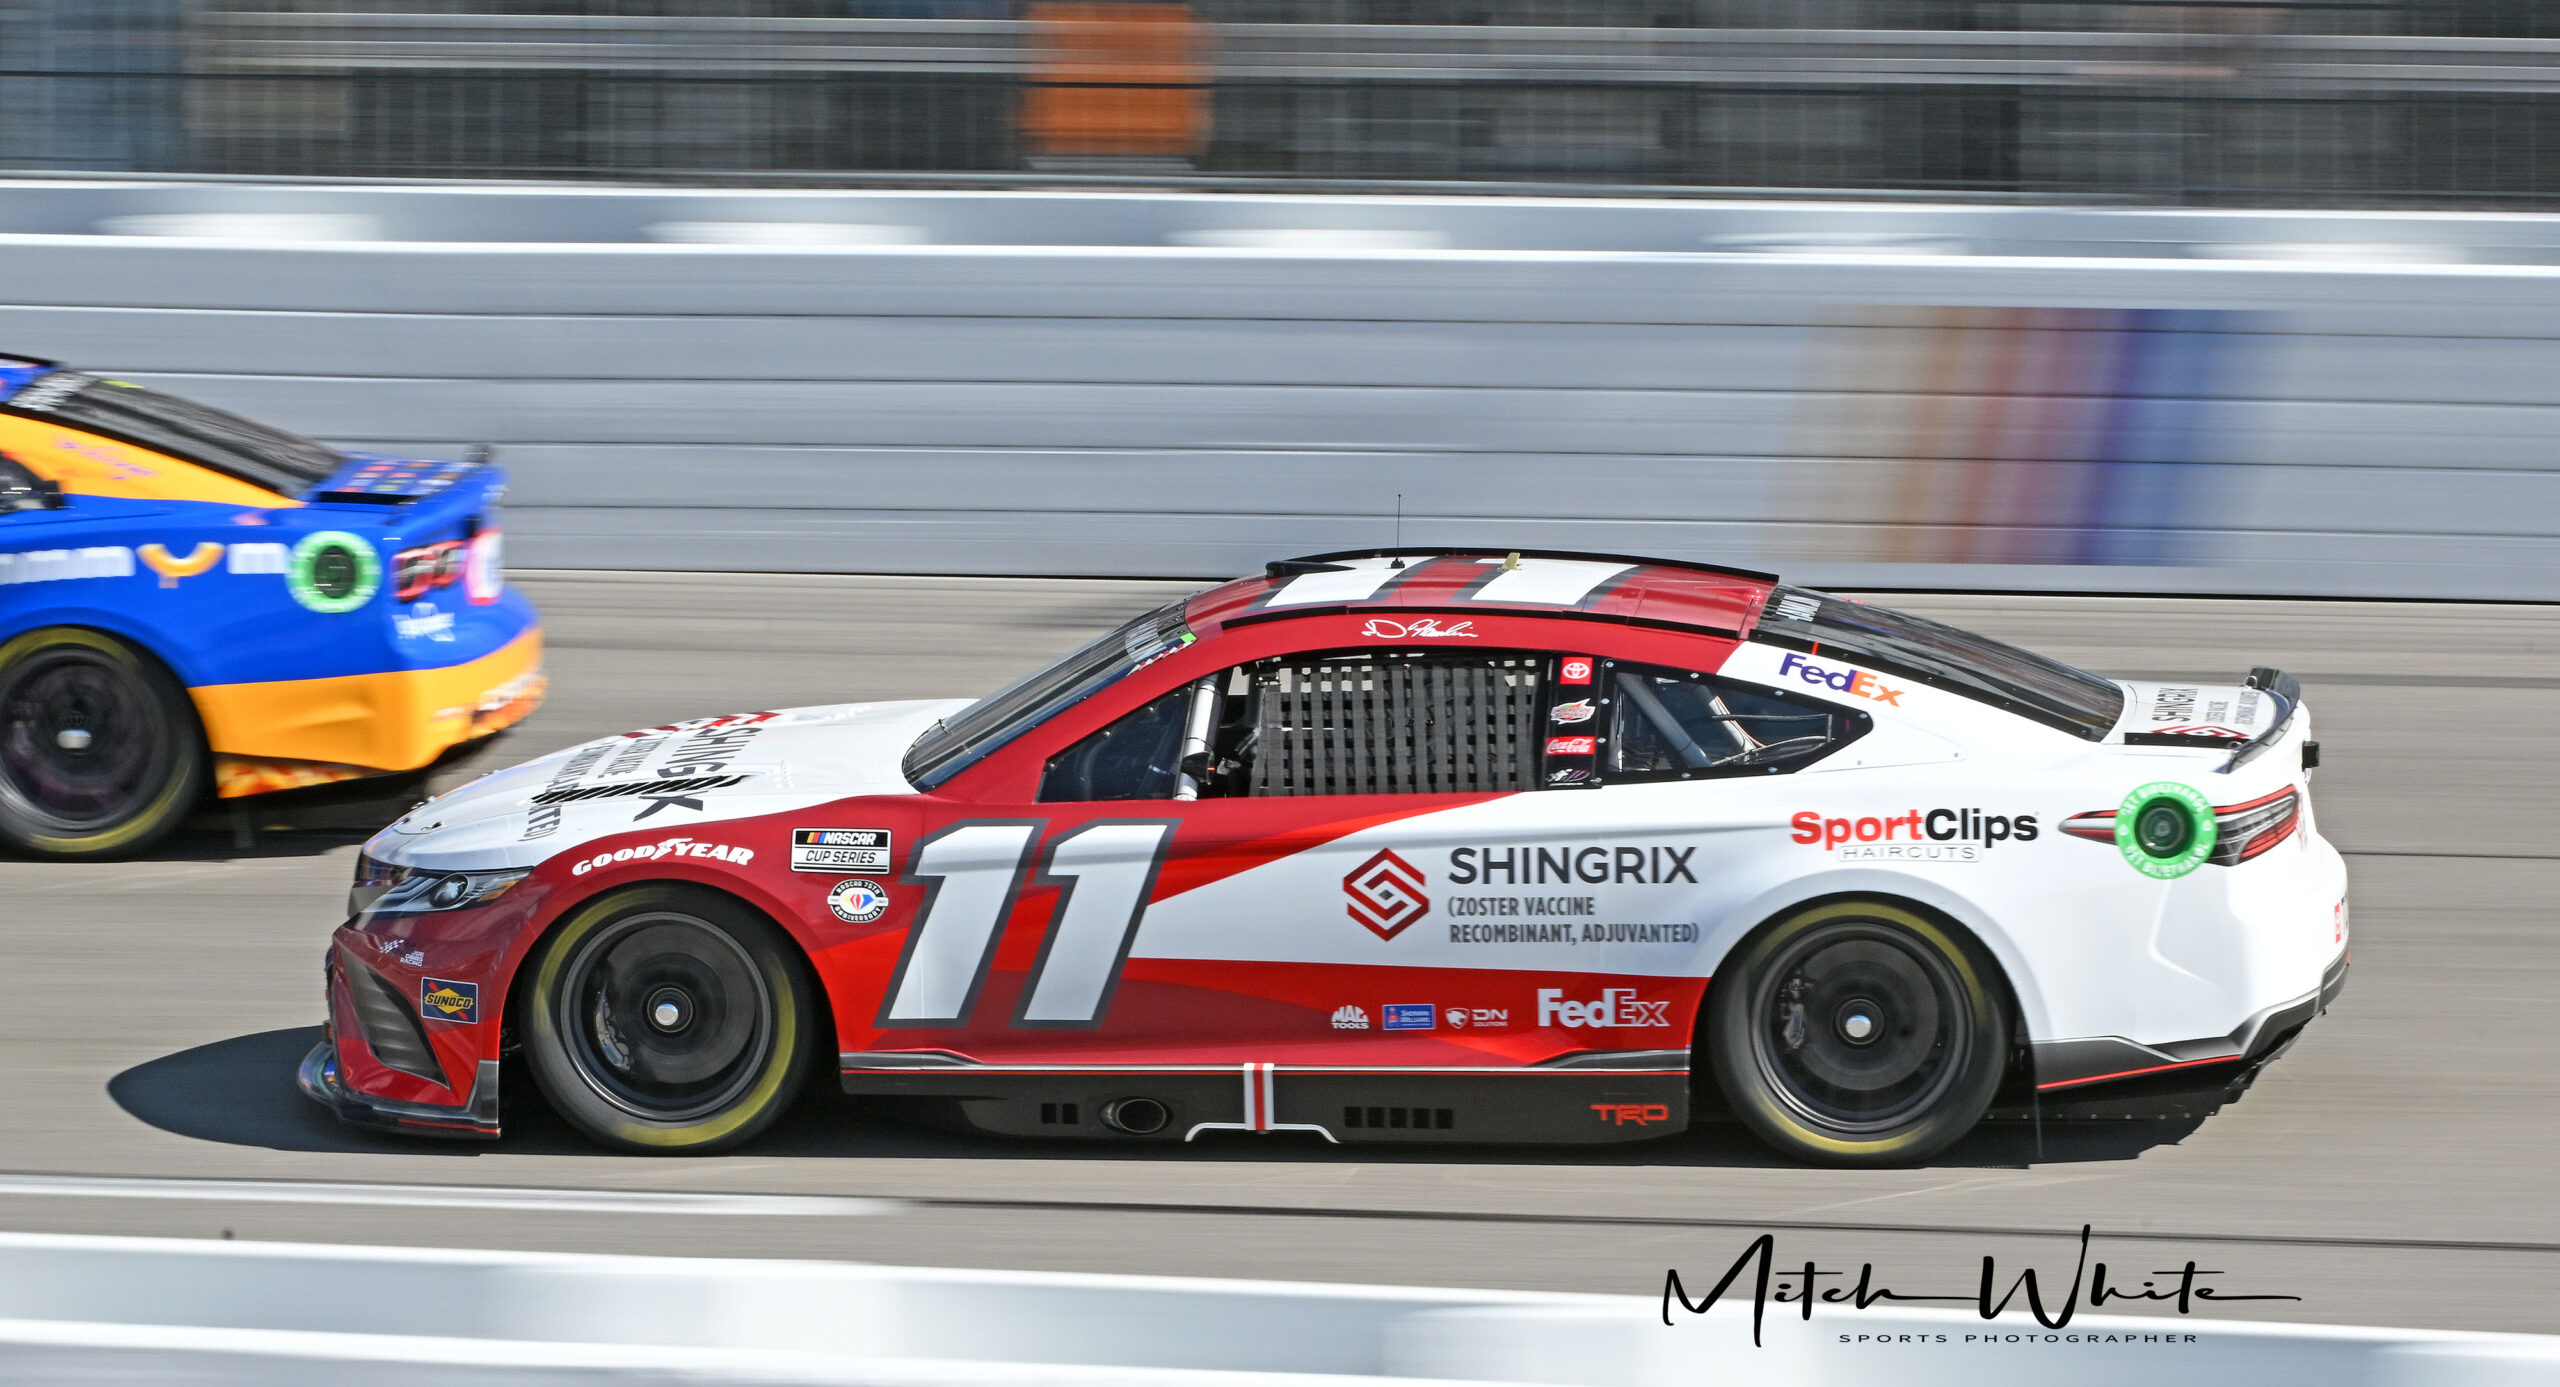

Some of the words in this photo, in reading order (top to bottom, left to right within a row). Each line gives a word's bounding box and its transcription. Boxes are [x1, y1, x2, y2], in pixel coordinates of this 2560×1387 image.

[1779, 653, 1904, 706] FedEx
[823, 832, 877, 846] NASCAR
[572, 837, 755, 876] GOODYEAR
[806, 850, 831, 862] CUP
[832, 851, 876, 864] SERIES
[1843, 846, 1976, 859] HAIRCUTS
[1448, 847, 1699, 885] SHINGRIX
[836, 881, 864, 895] NASCAR
[864, 882, 881, 895] 75TH
[1448, 896, 1519, 917] (ZOSTER
[1524, 897, 1595, 916] VACCINE
[872, 817, 1184, 1030] 11
[1449, 923, 1576, 945] RECOMBINANT,
[1582, 923, 1700, 944] ADJUVANTED)
[426, 995, 472, 1008] SUNOCO
[1537, 987, 1671, 1028] FedEx
[1331, 1005, 1369, 1022] MAC
[1472, 1009, 1508, 1020] DN
[1590, 1103, 1669, 1126] TRD
